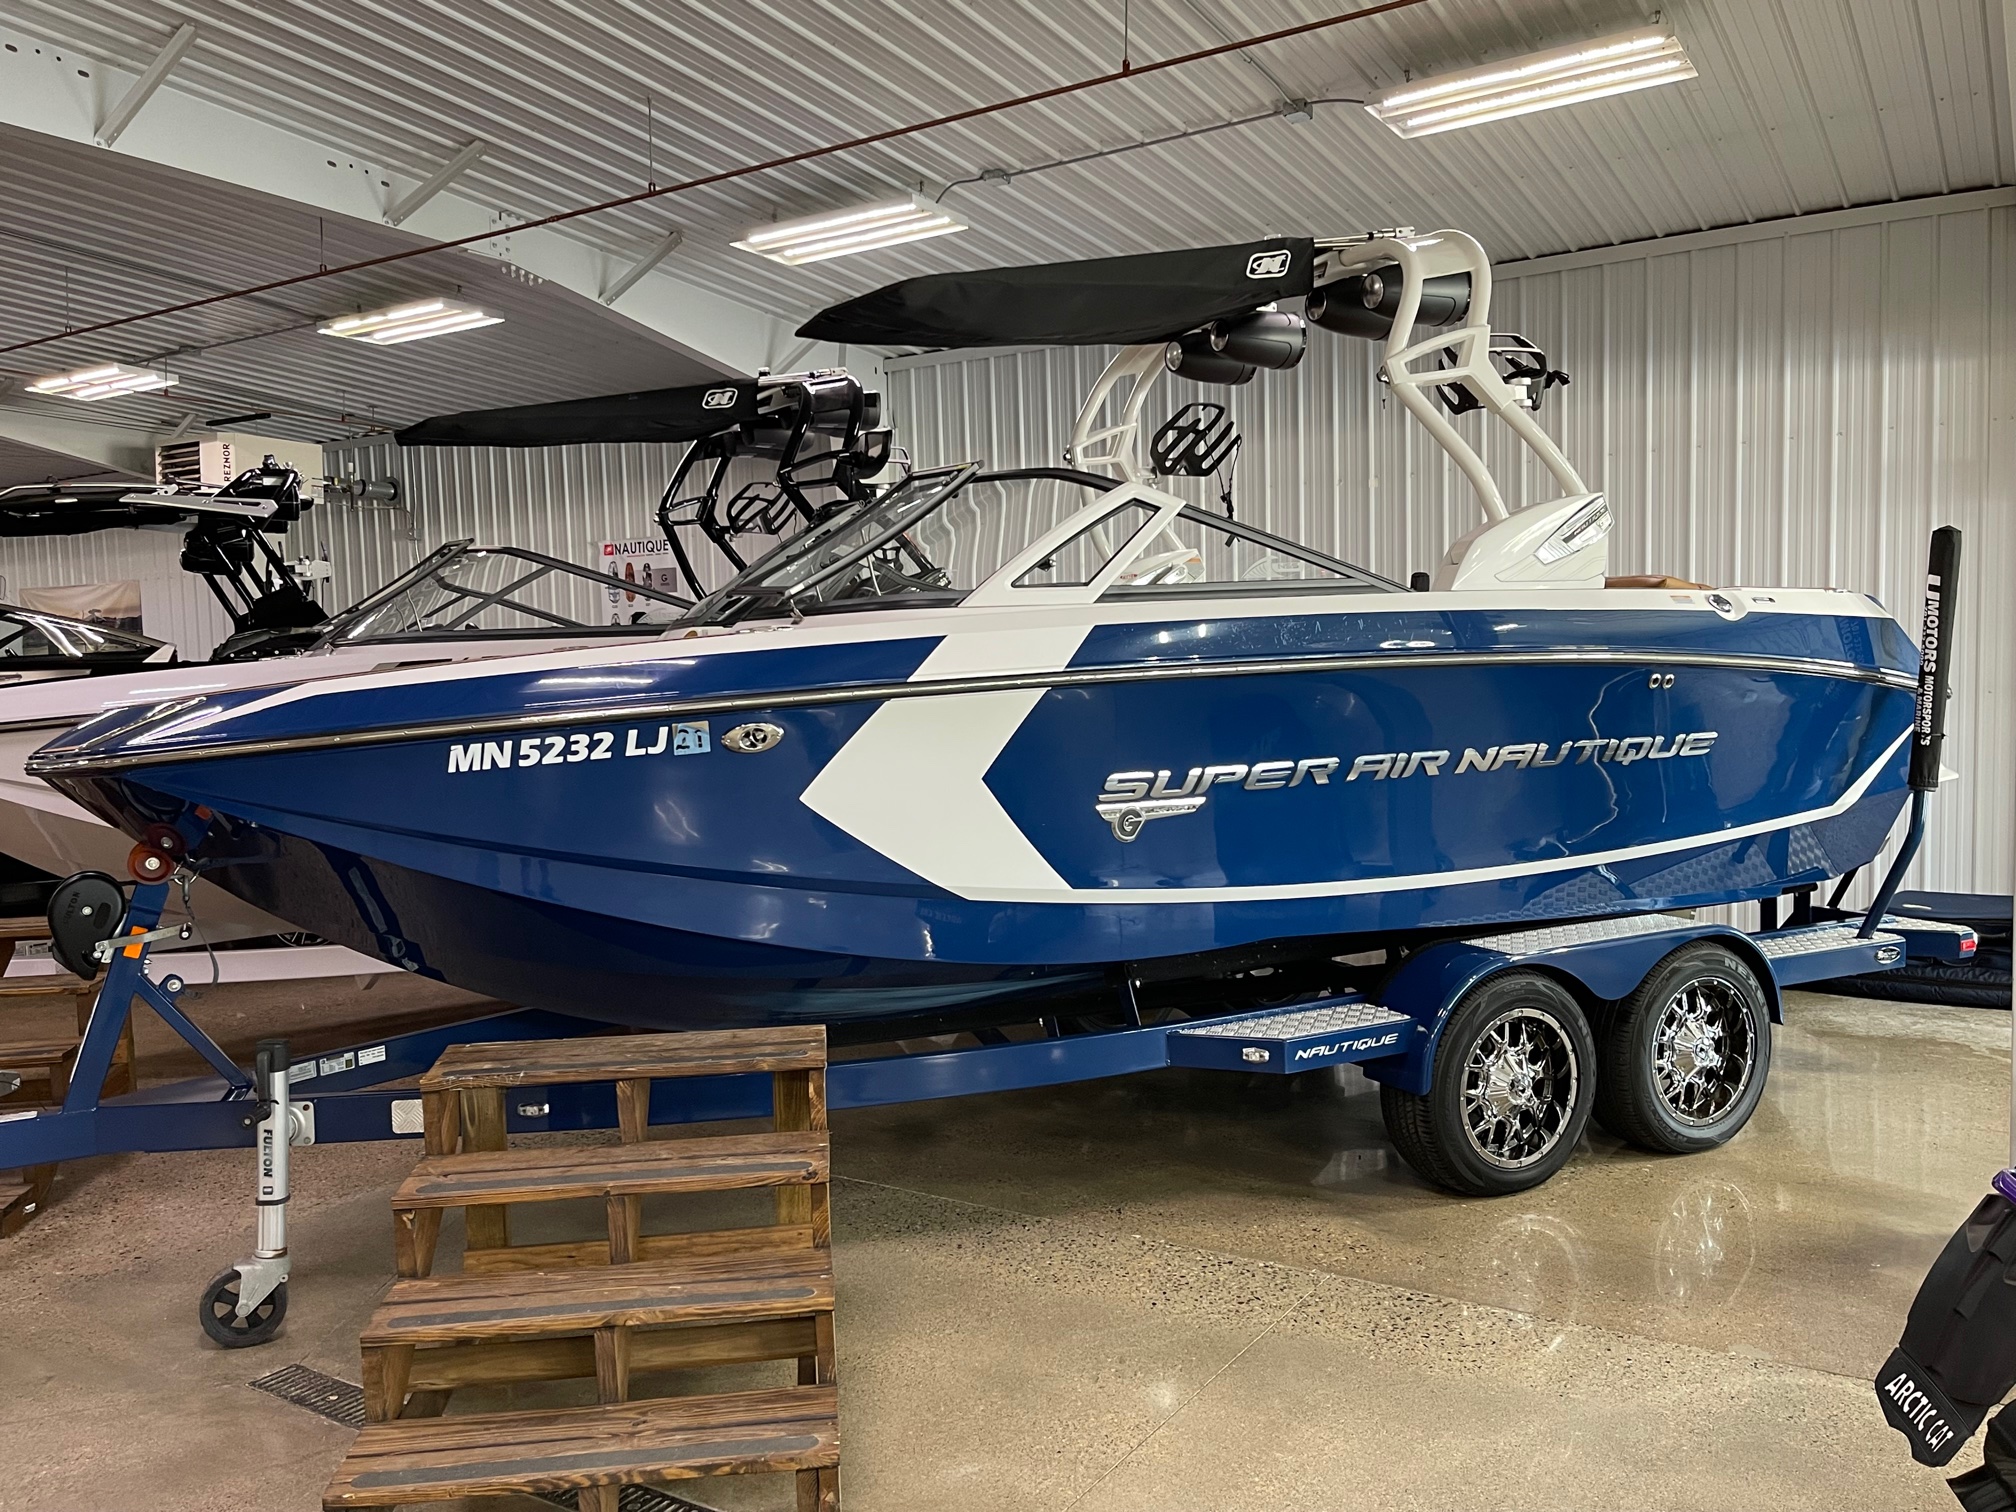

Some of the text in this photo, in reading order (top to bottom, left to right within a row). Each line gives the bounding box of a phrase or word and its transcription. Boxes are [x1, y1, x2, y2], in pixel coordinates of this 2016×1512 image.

[222, 443, 231, 482] REZNOR
[614, 539, 670, 556] NAUTIQUE
[1914, 696, 1923, 733] MARINE
[447, 726, 669, 774] MN 5232 LJ
[1098, 731, 1718, 801] SUPER AIR NAUTIQUE
[1294, 1033, 1399, 1061] NAUTIQUE
[263, 1129, 273, 1178] FULTON
[1884, 1372, 1954, 1453] ARCTIC CAT
